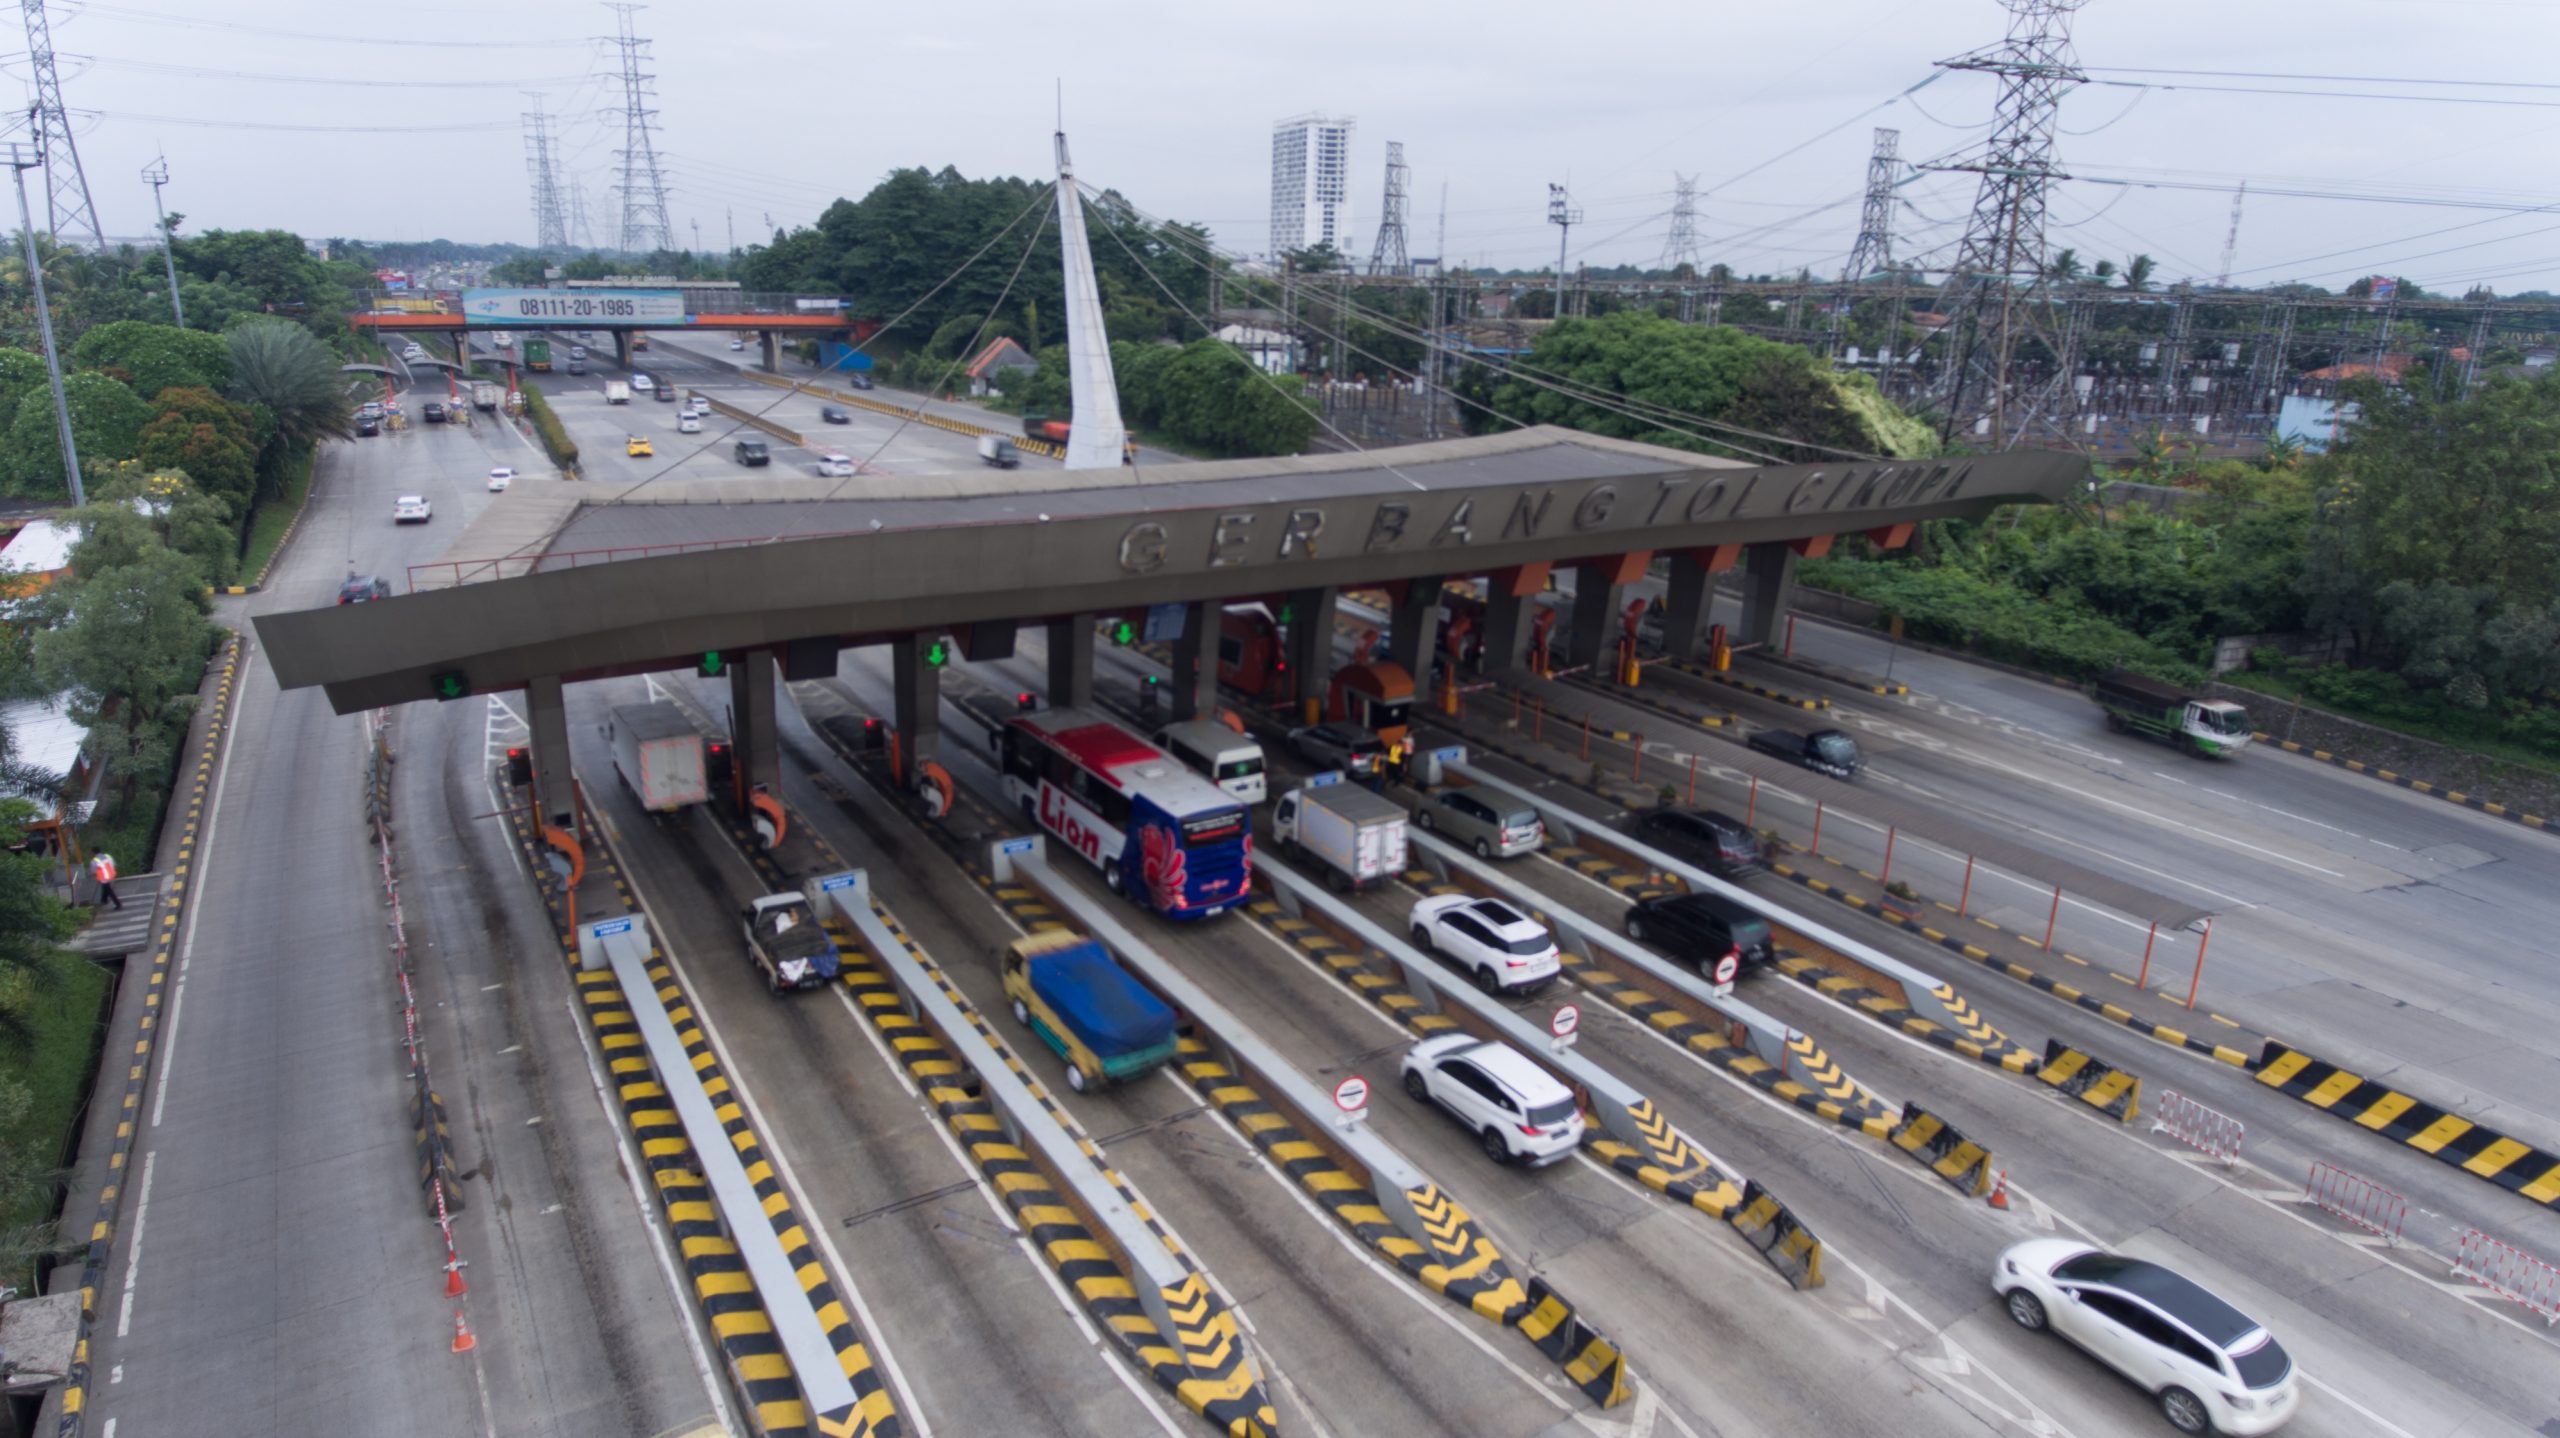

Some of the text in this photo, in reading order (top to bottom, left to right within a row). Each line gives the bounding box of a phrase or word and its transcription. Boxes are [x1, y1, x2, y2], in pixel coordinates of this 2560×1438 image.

[520, 299, 634, 316] 08111-20-1985
[1118, 462, 1975, 574] GERBANG TOL CIKUPA
[1040, 783, 1100, 861] Lion
